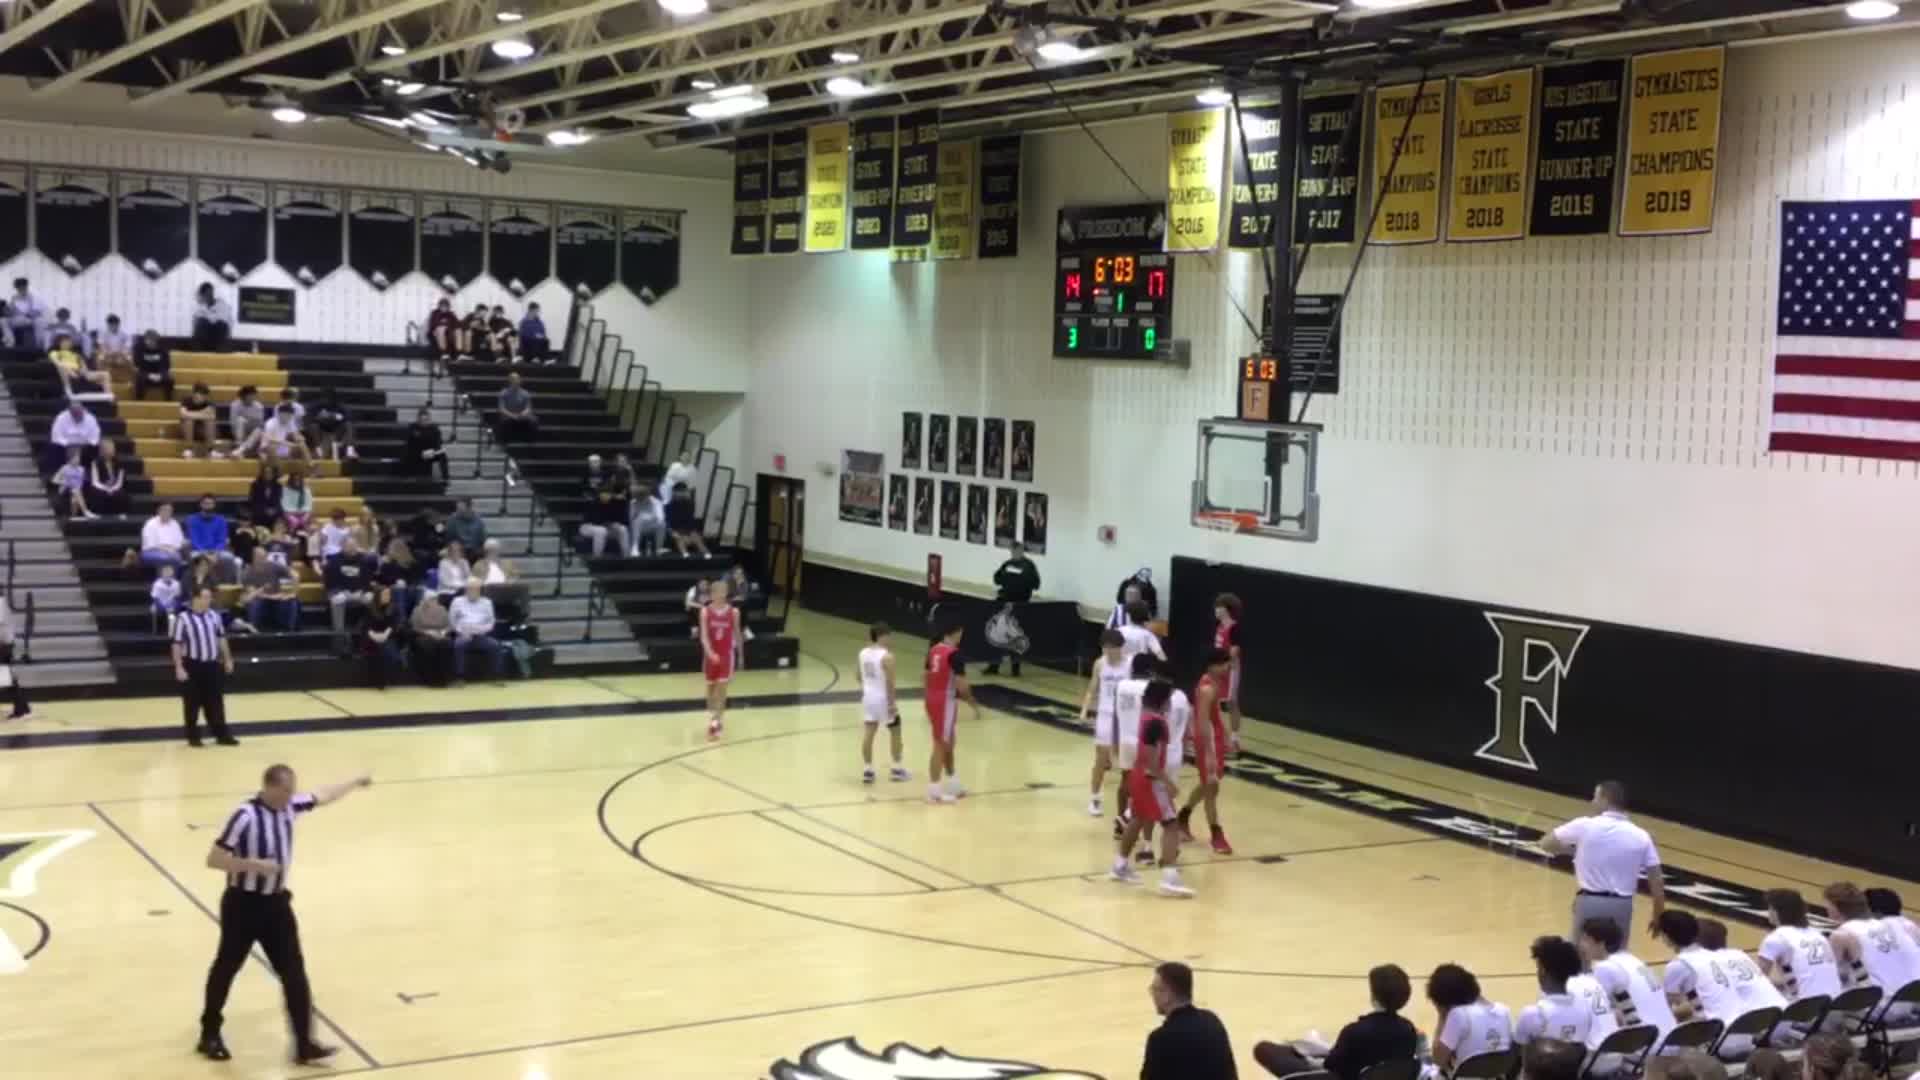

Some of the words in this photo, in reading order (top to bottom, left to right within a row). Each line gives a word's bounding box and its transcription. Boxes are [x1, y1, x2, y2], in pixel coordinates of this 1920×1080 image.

[1556, 118, 1601, 142] STATE
[1650, 108, 1700, 134] STATE
[1247, 151, 1279, 171] TATE
[1472, 147, 1509, 171] STATE
[1539, 156, 1613, 182] RUNNER-UP
[1631, 148, 1714, 176] CHAMPIONS
[1459, 171, 1521, 196] CHAMPIONS
[1551, 194, 1594, 217] 2019
[1645, 189, 1692, 214] 2019
[1241, 215, 1272, 235] 207
[1385, 210, 1420, 232] 2018
[1466, 207, 1504, 229] 2018
[1065, 272, 1081, 298] 14
[1147, 270, 1166, 297] 17
[1066, 326, 1078, 350] 3
[1143, 326, 1156, 350] 0
[1474, 611, 1591, 771] F
